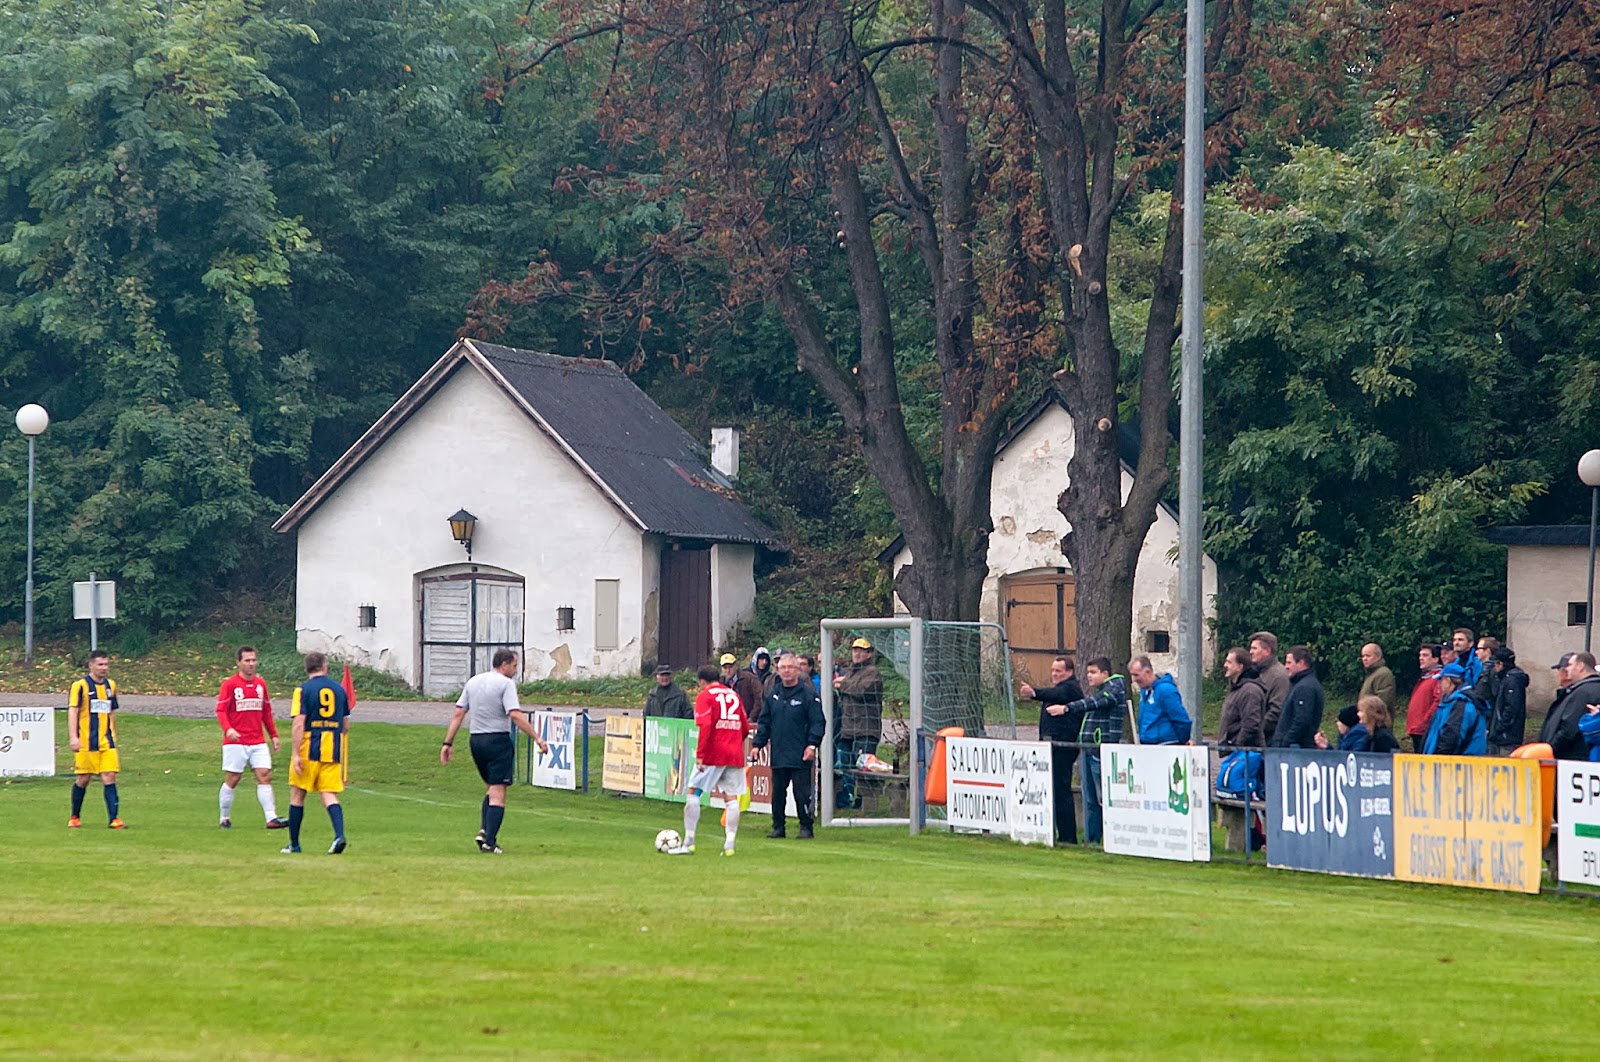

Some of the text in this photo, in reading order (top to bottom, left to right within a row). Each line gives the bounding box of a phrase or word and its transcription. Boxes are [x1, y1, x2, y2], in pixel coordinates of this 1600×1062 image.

[233, 687, 245, 700] 8
[319, 688, 335, 718] 9
[715, 693, 740, 720] 12
[645, 720, 659, 754] BIO
[548, 743, 571, 770] XL
[951, 745, 1005, 775] SALOMON
[953, 792, 1007, 823] AUTOMATION
[1280, 761, 1349, 838] LUPUS
[1453, 837, 1485, 883] SEINE
[1491, 829, 1525, 887] GÄSTE
